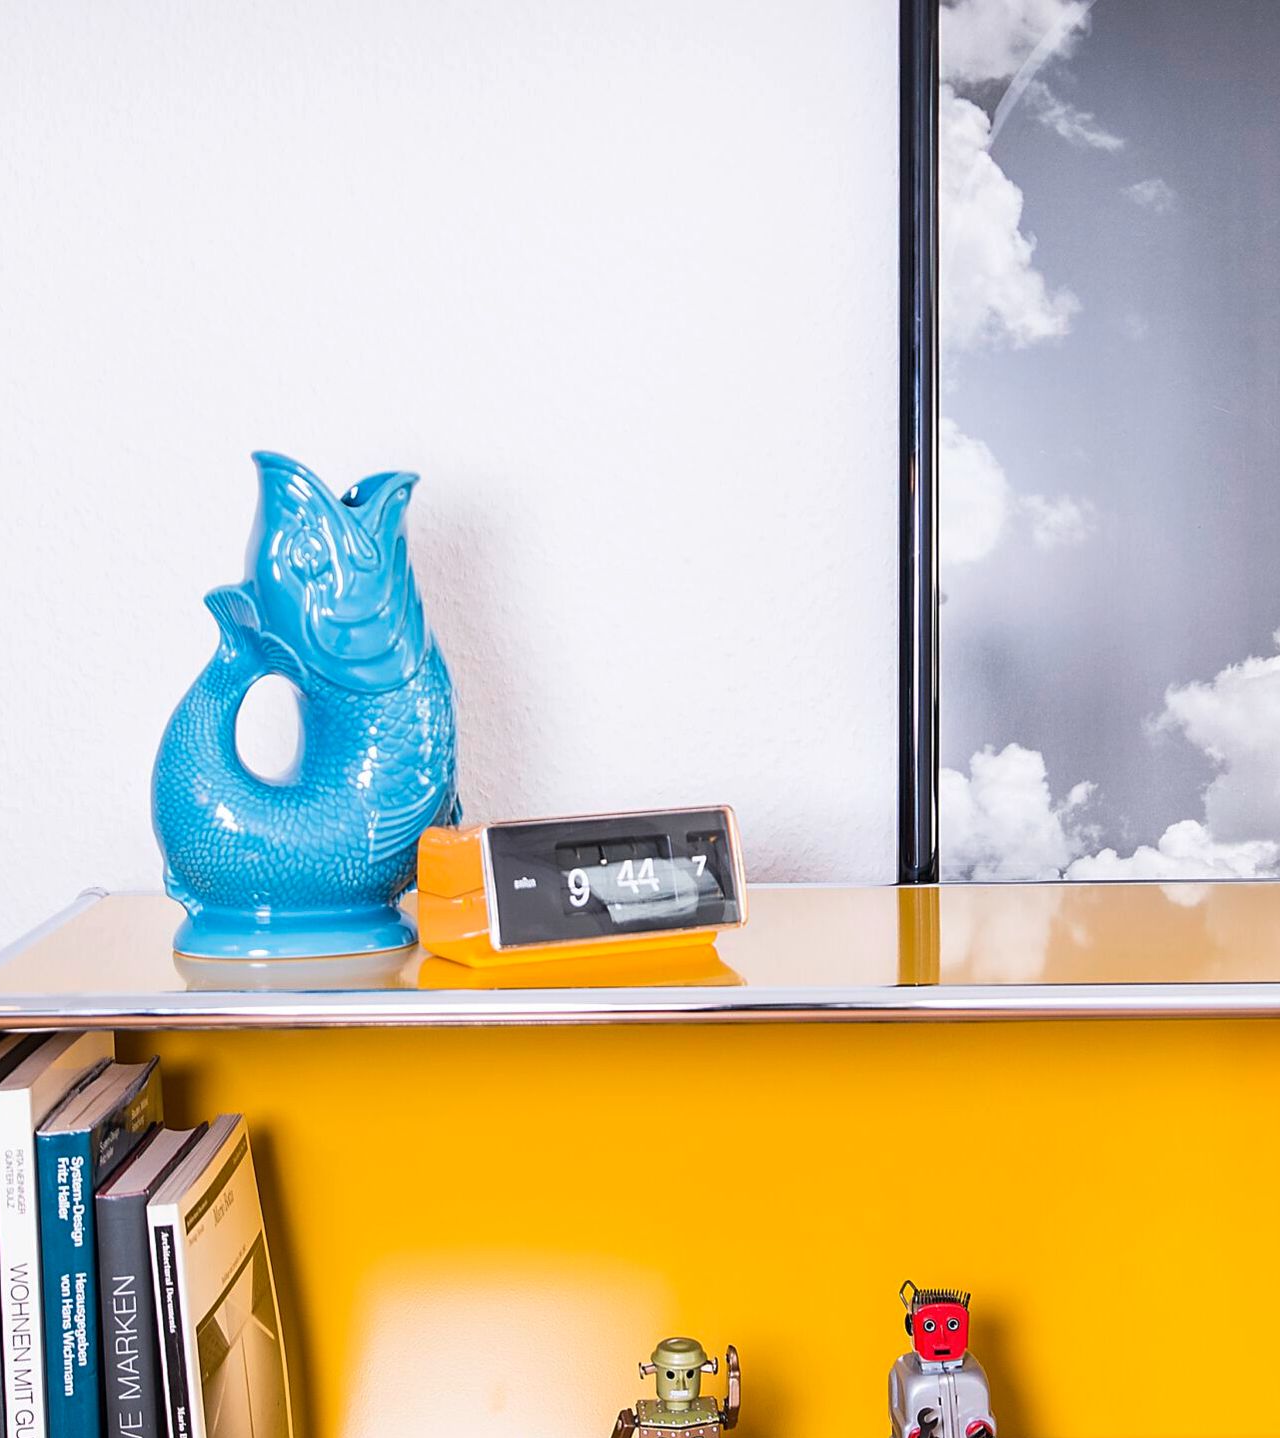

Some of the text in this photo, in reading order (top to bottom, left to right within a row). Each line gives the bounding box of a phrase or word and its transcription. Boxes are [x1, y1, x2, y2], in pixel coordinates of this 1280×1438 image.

[567, 868, 590, 907] 9
[691, 856, 707, 878] 7
[57, 1157, 70, 1221] Fritz Haller
[70, 1155, 85, 1247] System-Design
[160, 1230, 173, 1286] Architectural
[60, 1274, 70, 1295] von
[10, 1263, 32, 1362] WOHNEN
[61, 1297, 72, 1330] Hans
[74, 1273, 87, 1367] Herausgegeben
[112, 1275, 141, 1400] MARKEN
[13, 1369, 33, 1404] MIT
[177, 1406, 186, 1432] Mario
